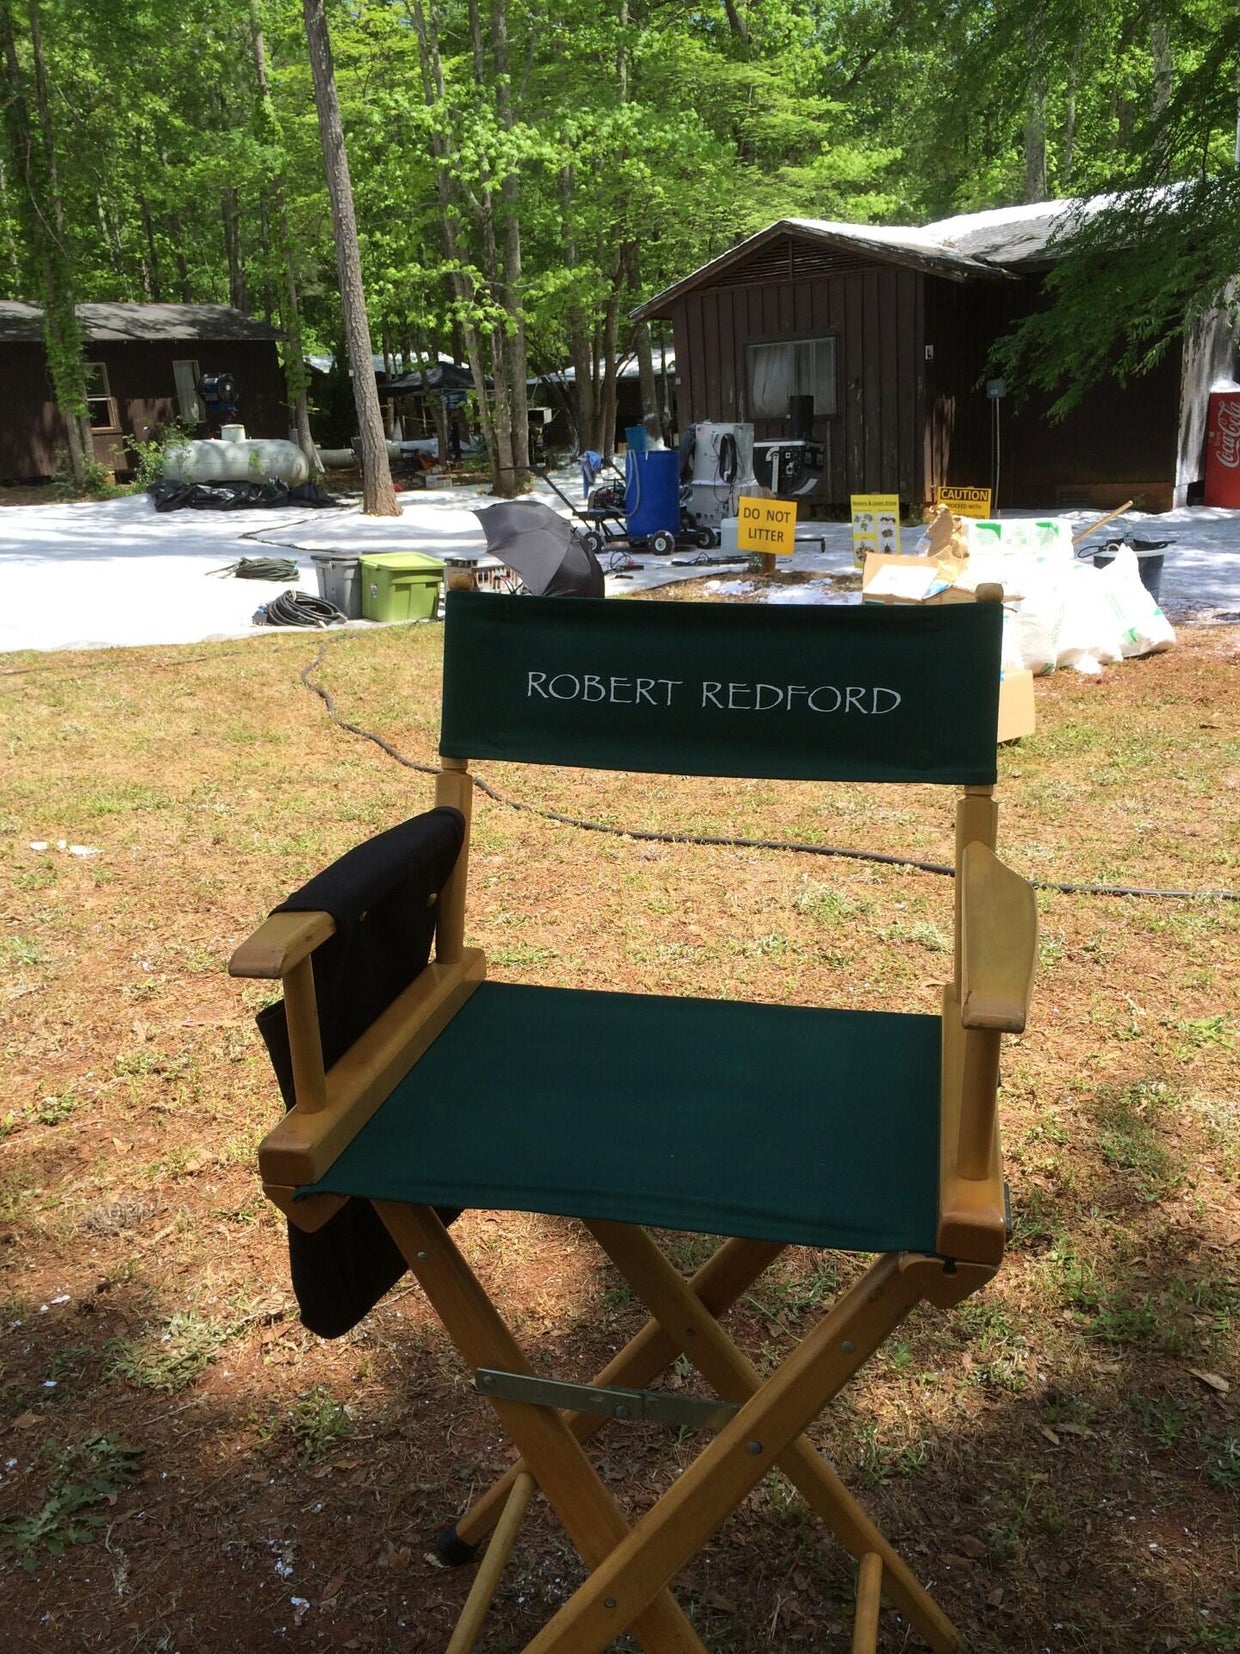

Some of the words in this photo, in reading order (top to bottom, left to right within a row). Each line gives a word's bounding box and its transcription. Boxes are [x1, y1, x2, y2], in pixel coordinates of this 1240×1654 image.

[941, 489, 988, 501] CAUTION
[743, 507, 760, 520] DO
[766, 509, 791, 523] NOT
[748, 527, 784, 543] LITTER
[527, 671, 683, 706] ROBERT
[701, 681, 902, 715] REDFORD
